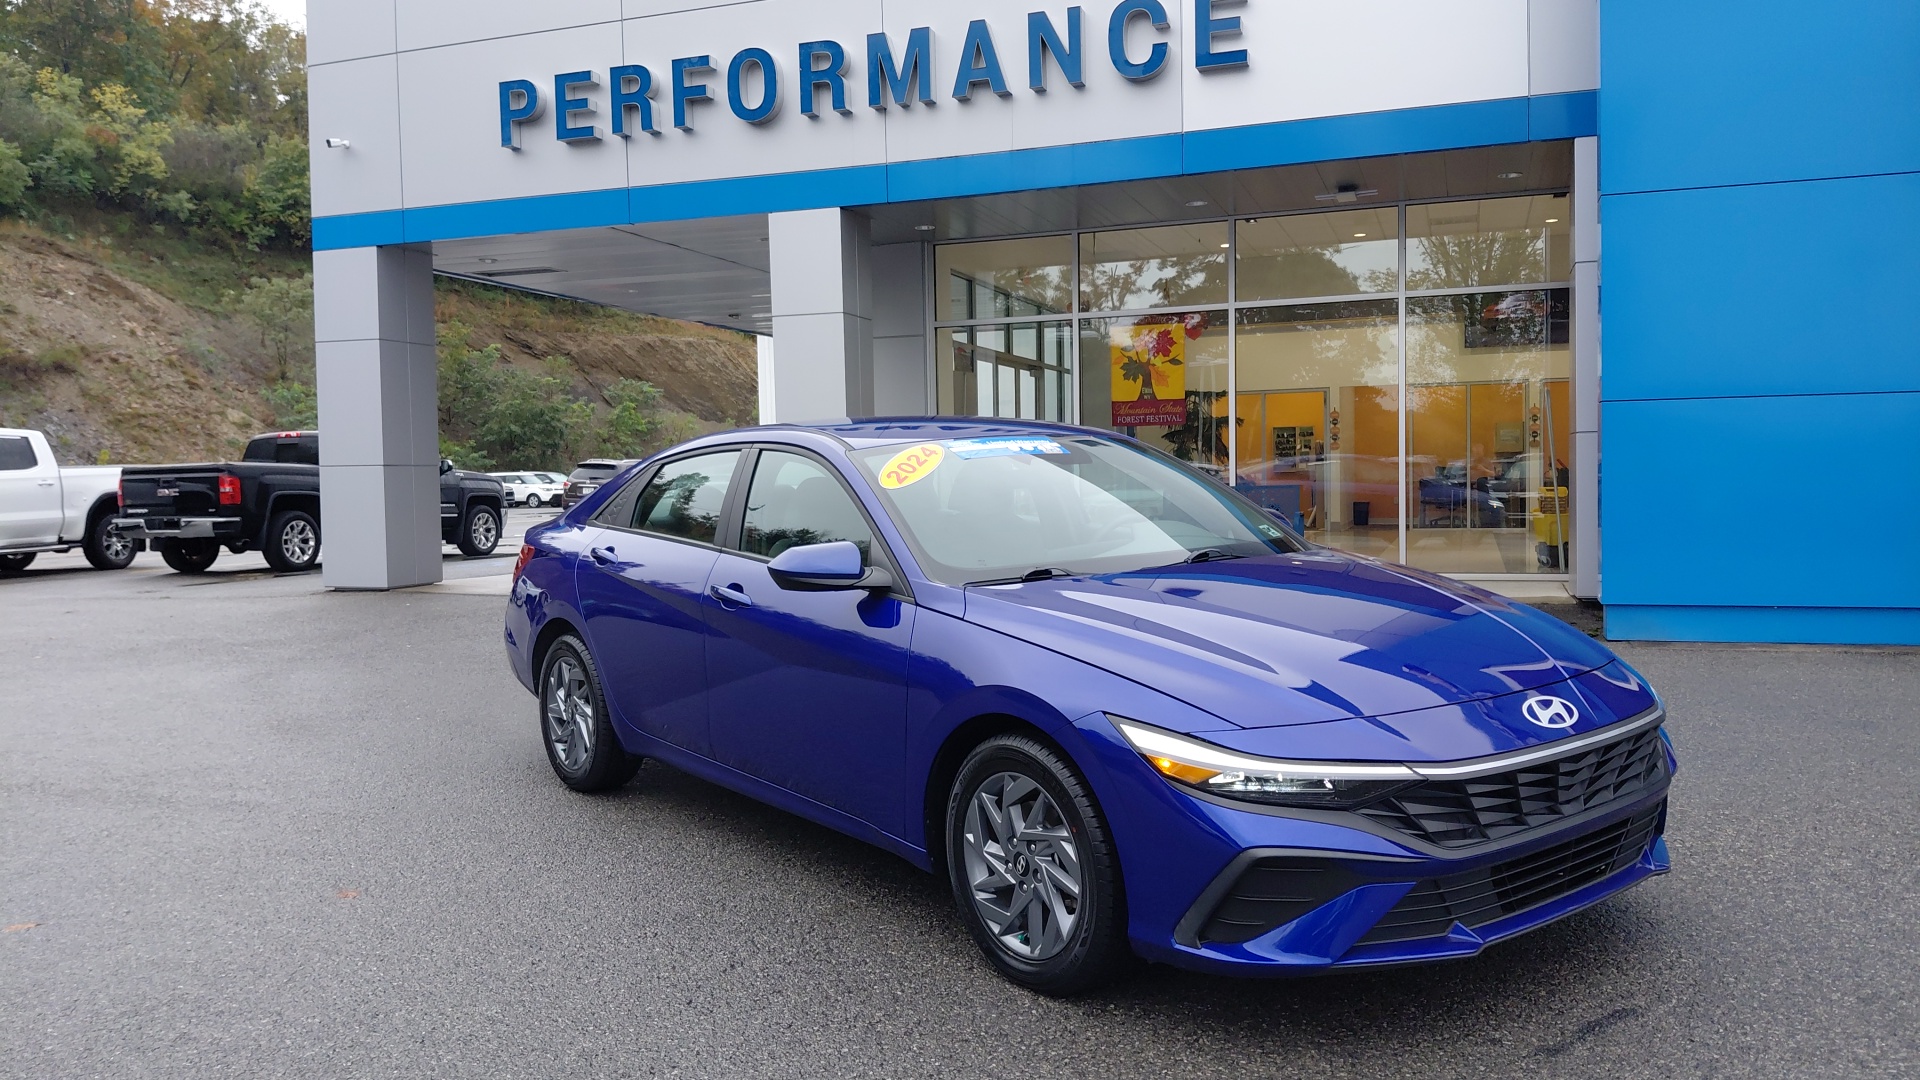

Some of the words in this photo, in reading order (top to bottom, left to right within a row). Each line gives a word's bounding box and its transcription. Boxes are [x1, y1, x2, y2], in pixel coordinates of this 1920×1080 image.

[499, 0, 1249, 151] PERFORMANCE
[1114, 403, 1156, 414] Mountain
[1159, 401, 1183, 414] State
[1117, 415, 1145, 424] FOREST
[1146, 414, 1182, 423] FESTIVAL
[886, 446, 938, 485] 2024
